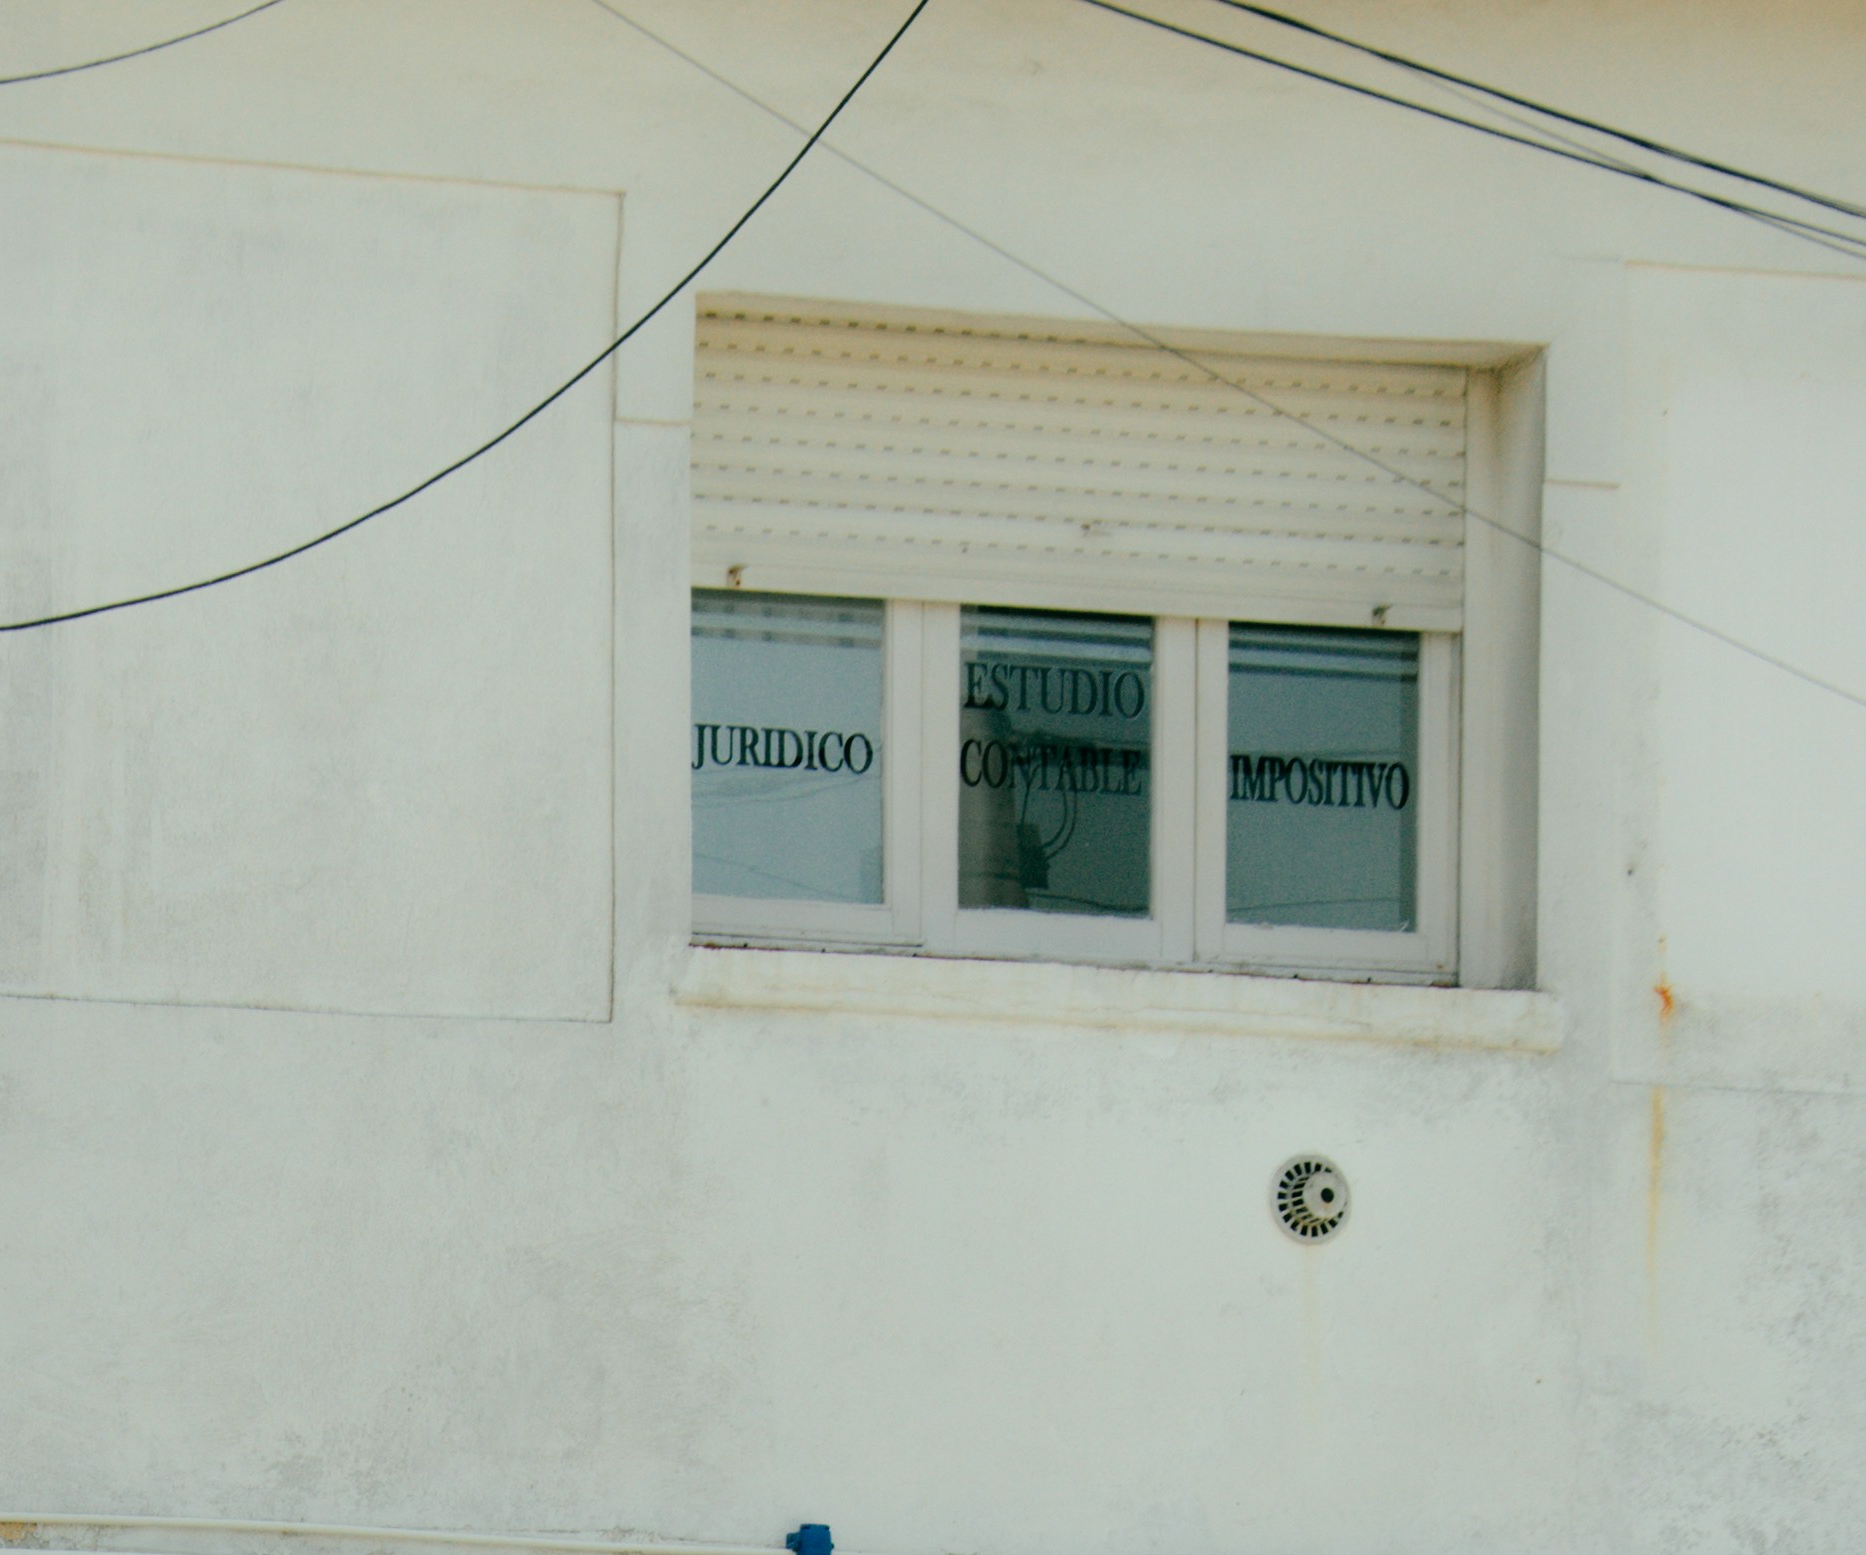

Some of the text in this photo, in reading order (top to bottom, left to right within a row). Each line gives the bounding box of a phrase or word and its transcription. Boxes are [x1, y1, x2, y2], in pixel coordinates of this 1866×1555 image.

[964, 661, 1146, 720] ESTUDIO
[690, 723, 875, 774] JURIDICO
[959, 737, 1143, 797] CONTABLE
[1229, 754, 1411, 811] IMPOSITIVO
